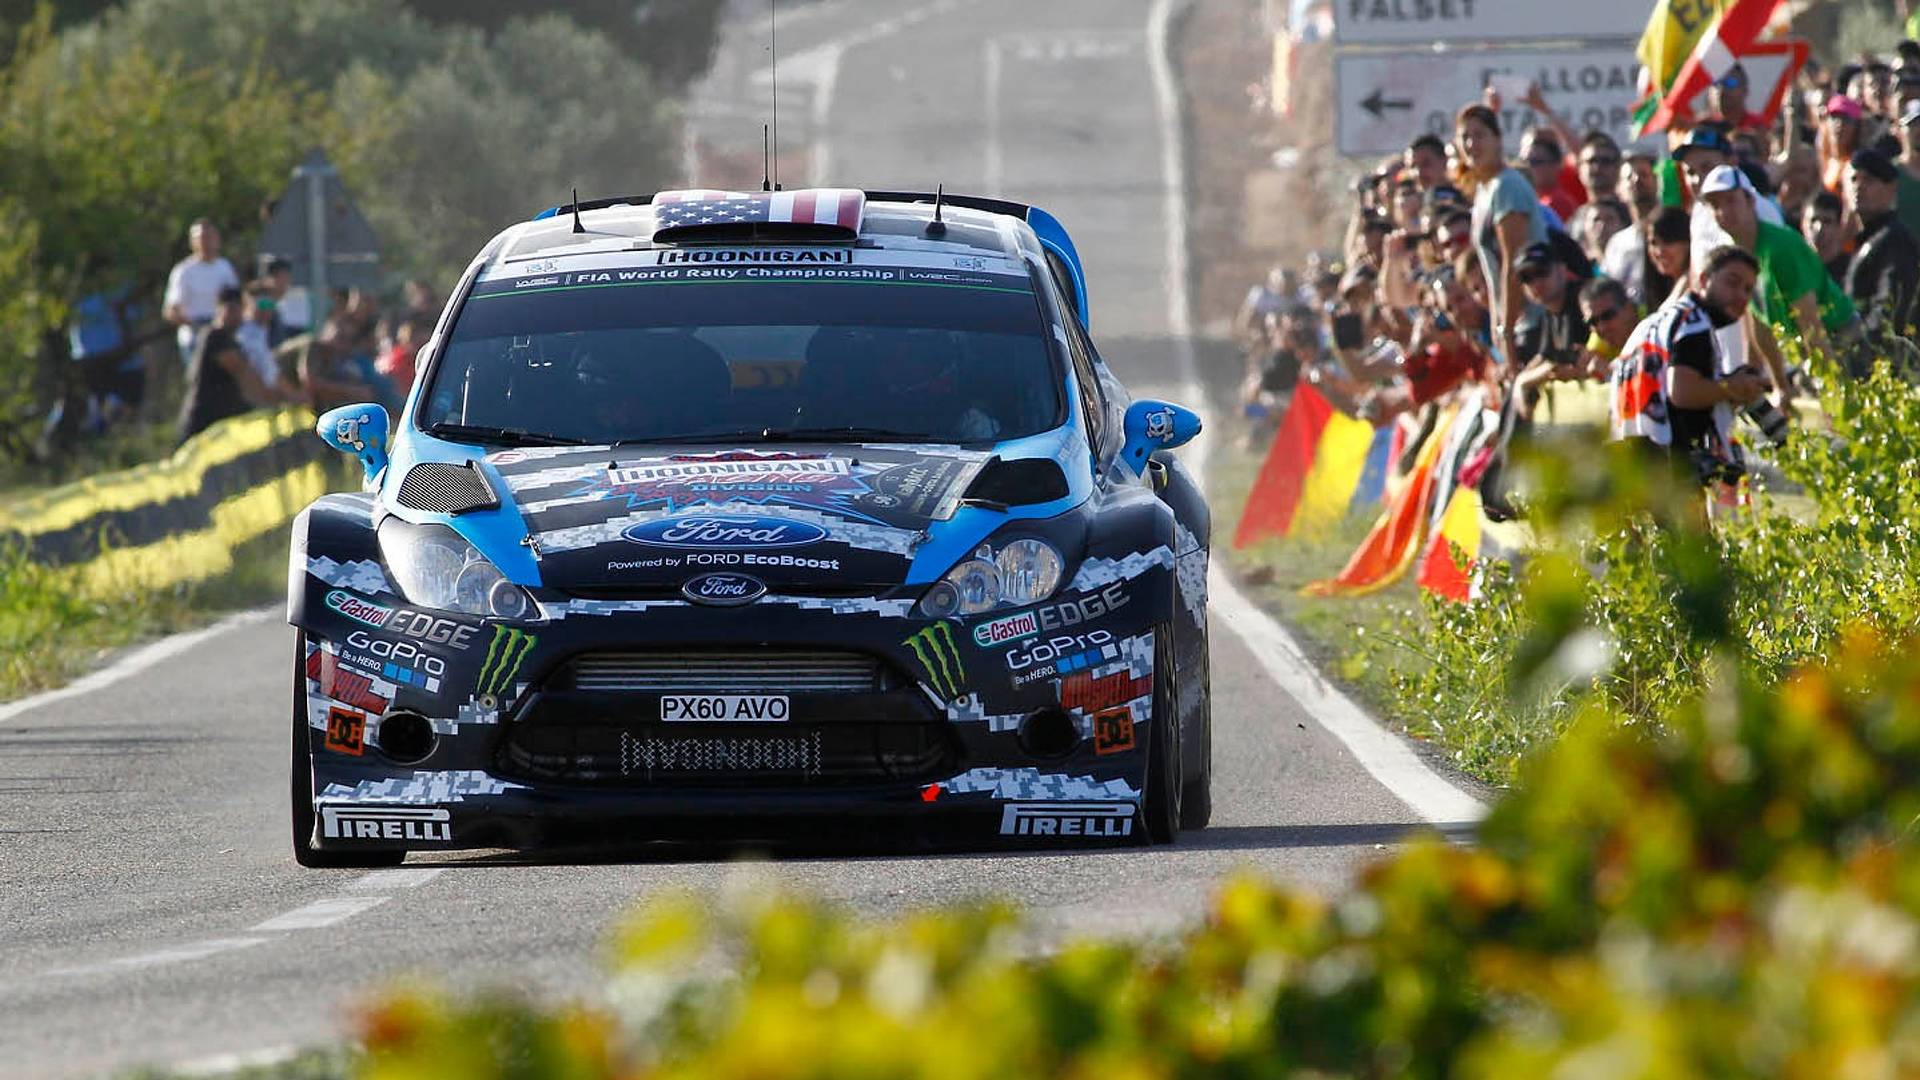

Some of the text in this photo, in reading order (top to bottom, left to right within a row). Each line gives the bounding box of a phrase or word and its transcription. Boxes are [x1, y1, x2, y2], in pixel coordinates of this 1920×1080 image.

[576, 267, 894, 283] FIA World Rally Championship
[689, 483, 813, 492] DIVISION
[661, 516, 788, 542] Ford
[607, 554, 840, 570] Powered by FORD EcoBoost
[700, 576, 748, 596] Ford
[989, 582, 1131, 642] Castrol EDGE
[339, 598, 480, 651] Castrol EDGE
[342, 650, 352, 661] Be
[346, 630, 446, 676] GoPro
[1005, 629, 1112, 670] GoPro
[1015, 675, 1025, 685] Be
[662, 697, 788, 719] PX60 AVO
[321, 806, 451, 841] PIRELLI
[1000, 803, 1136, 837] PIRELLI
